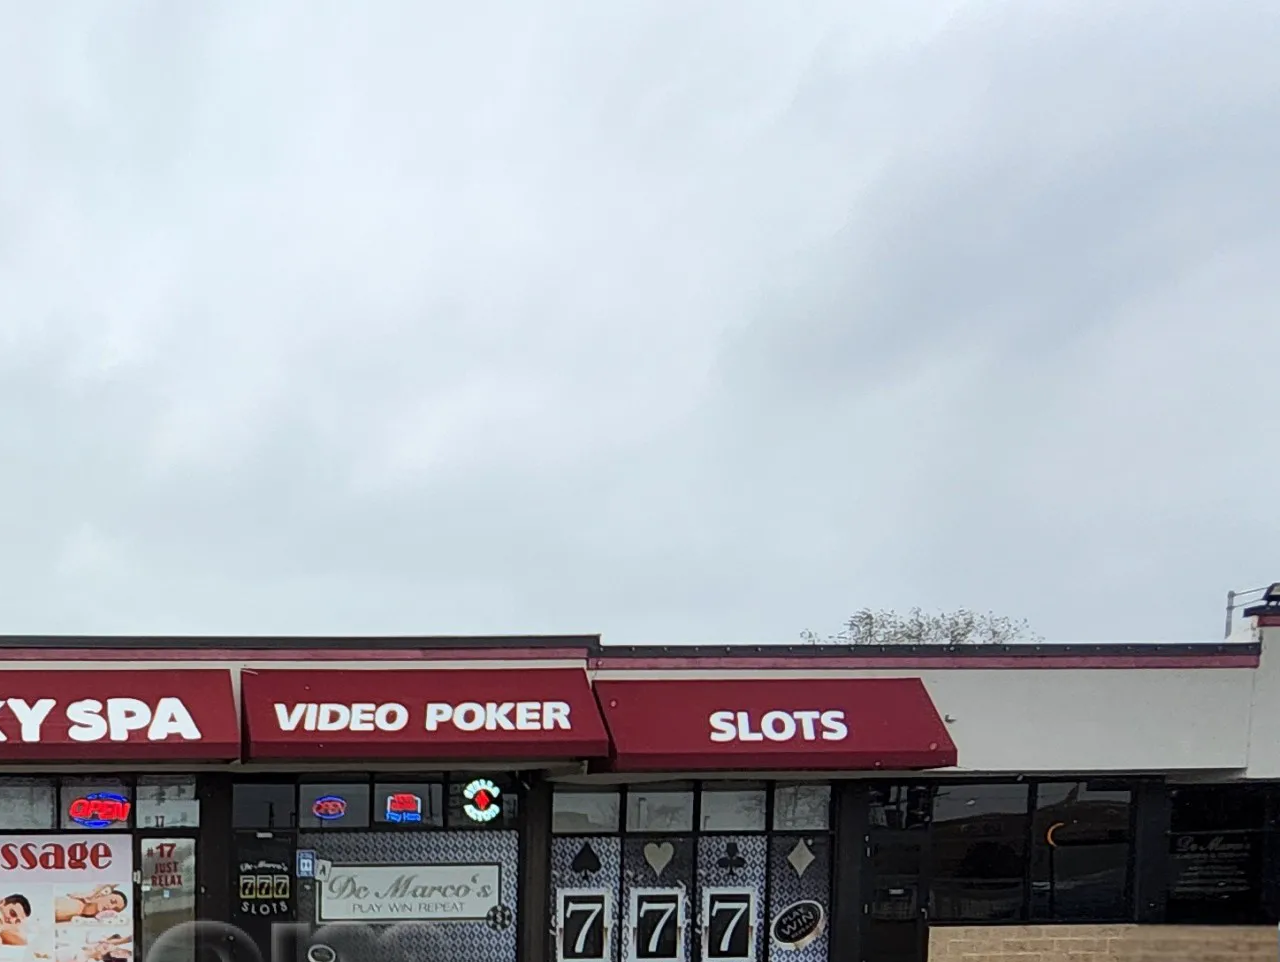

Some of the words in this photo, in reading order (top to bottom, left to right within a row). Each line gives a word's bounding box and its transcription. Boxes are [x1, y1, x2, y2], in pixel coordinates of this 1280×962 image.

[66, 697, 201, 742] SPA
[274, 702, 409, 731] VIDEO
[425, 701, 571, 731] POKER
[709, 710, 848, 741] SLOTS
[69, 799, 131, 821] OPEN
[155, 862, 178, 874] JUST
[151, 875, 183, 887] RELAX
[326, 873, 370, 900] De
[374, 872, 493, 899] Marco's
[241, 901, 288, 915] SLOTS
[351, 903, 383, 913] PLAY
[388, 902, 413, 913] WIN
[418, 902, 465, 913] REPEAT
[565, 901, 602, 953] 7
[639, 901, 676, 953] 7
[711, 901, 748, 952] 7
[781, 911, 814, 935] WIN
